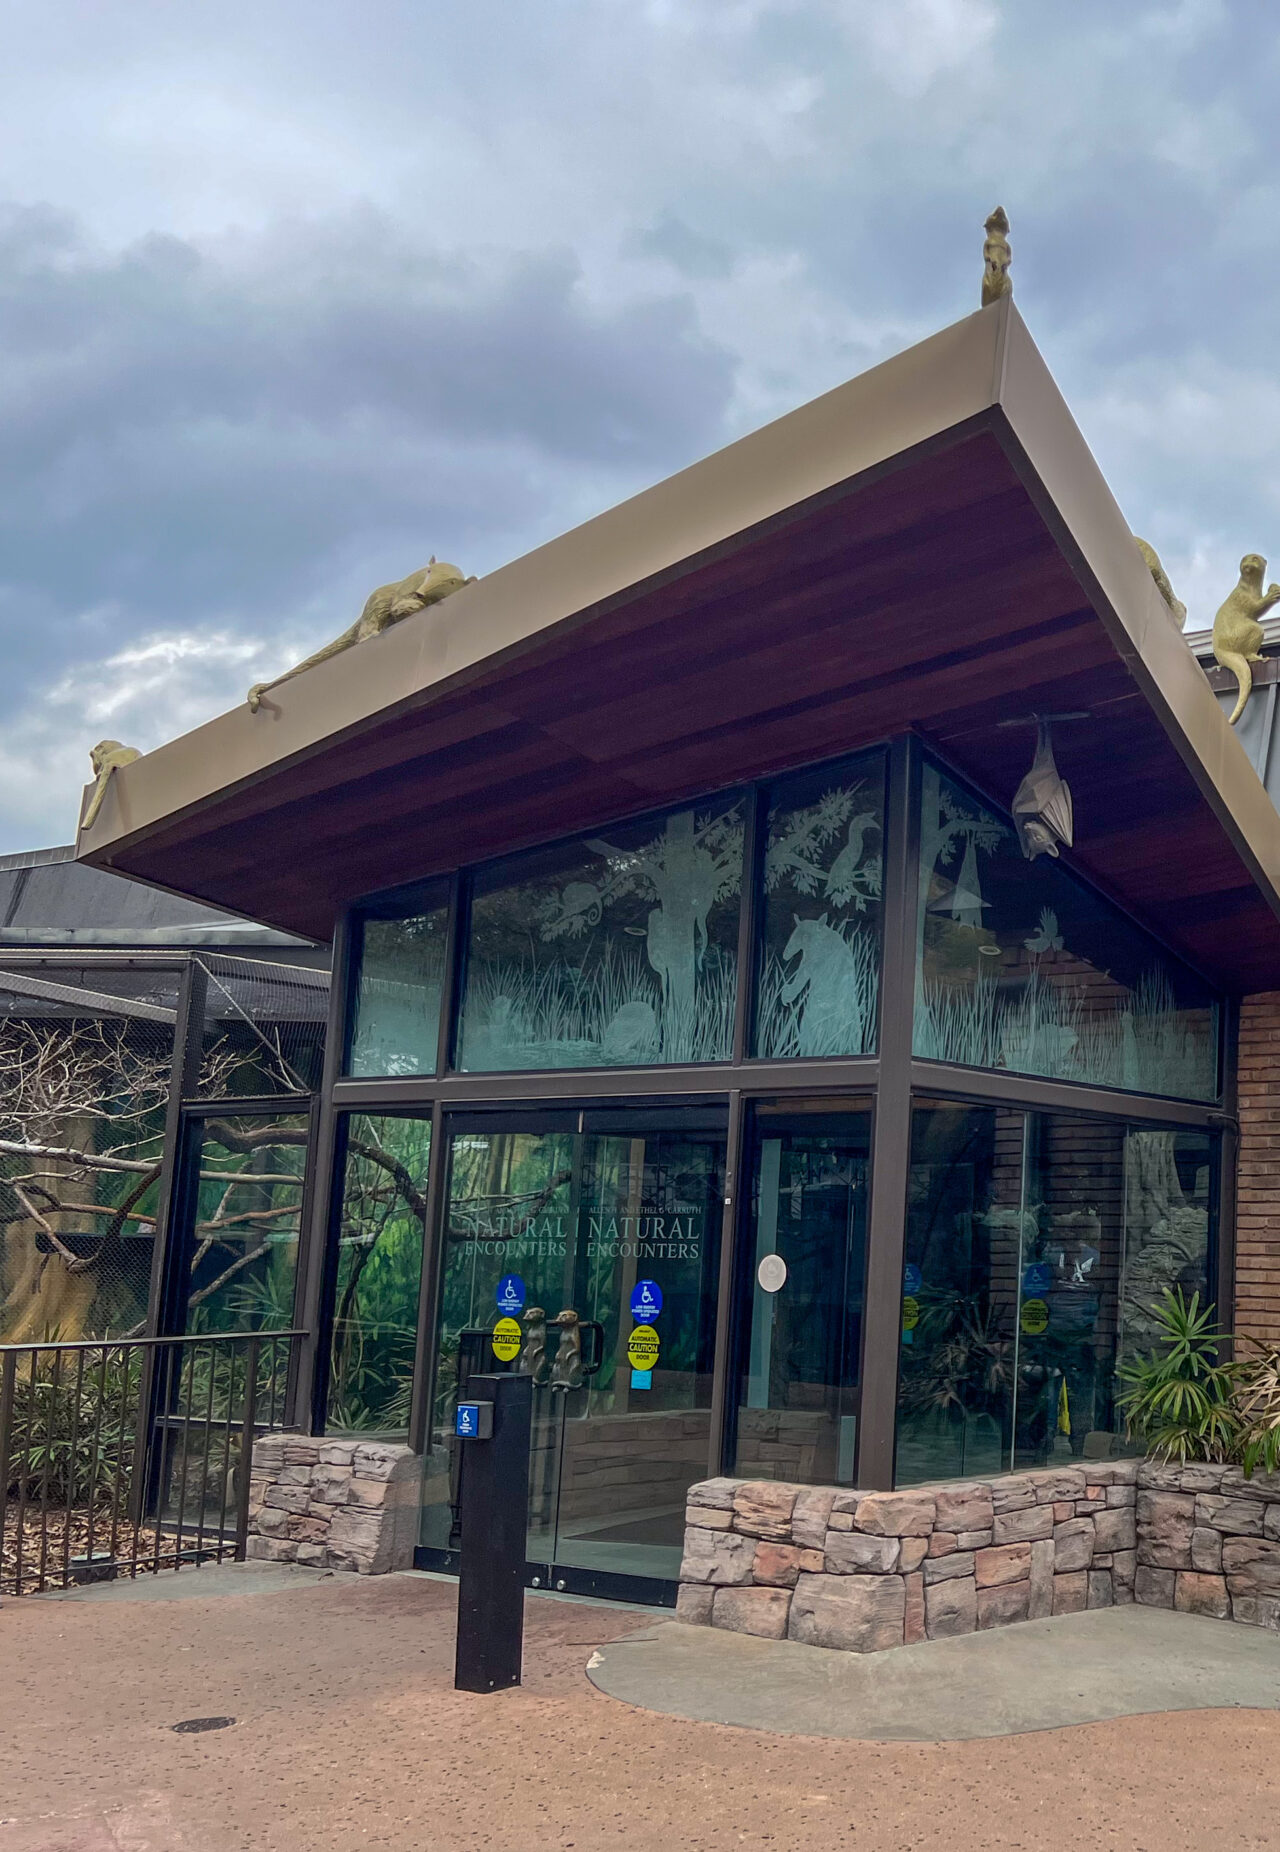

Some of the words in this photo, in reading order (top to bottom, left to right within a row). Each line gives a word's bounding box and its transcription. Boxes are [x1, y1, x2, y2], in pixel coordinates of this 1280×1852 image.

[465, 1216, 568, 1238] NATURAL
[588, 1217, 700, 1239] NATURAL
[465, 1241, 567, 1256] ENCOUNTERS
[586, 1242, 699, 1259] ENCOUNTERS
[493, 1335, 520, 1344] CAUTION
[629, 1344, 658, 1353] CAUTION
